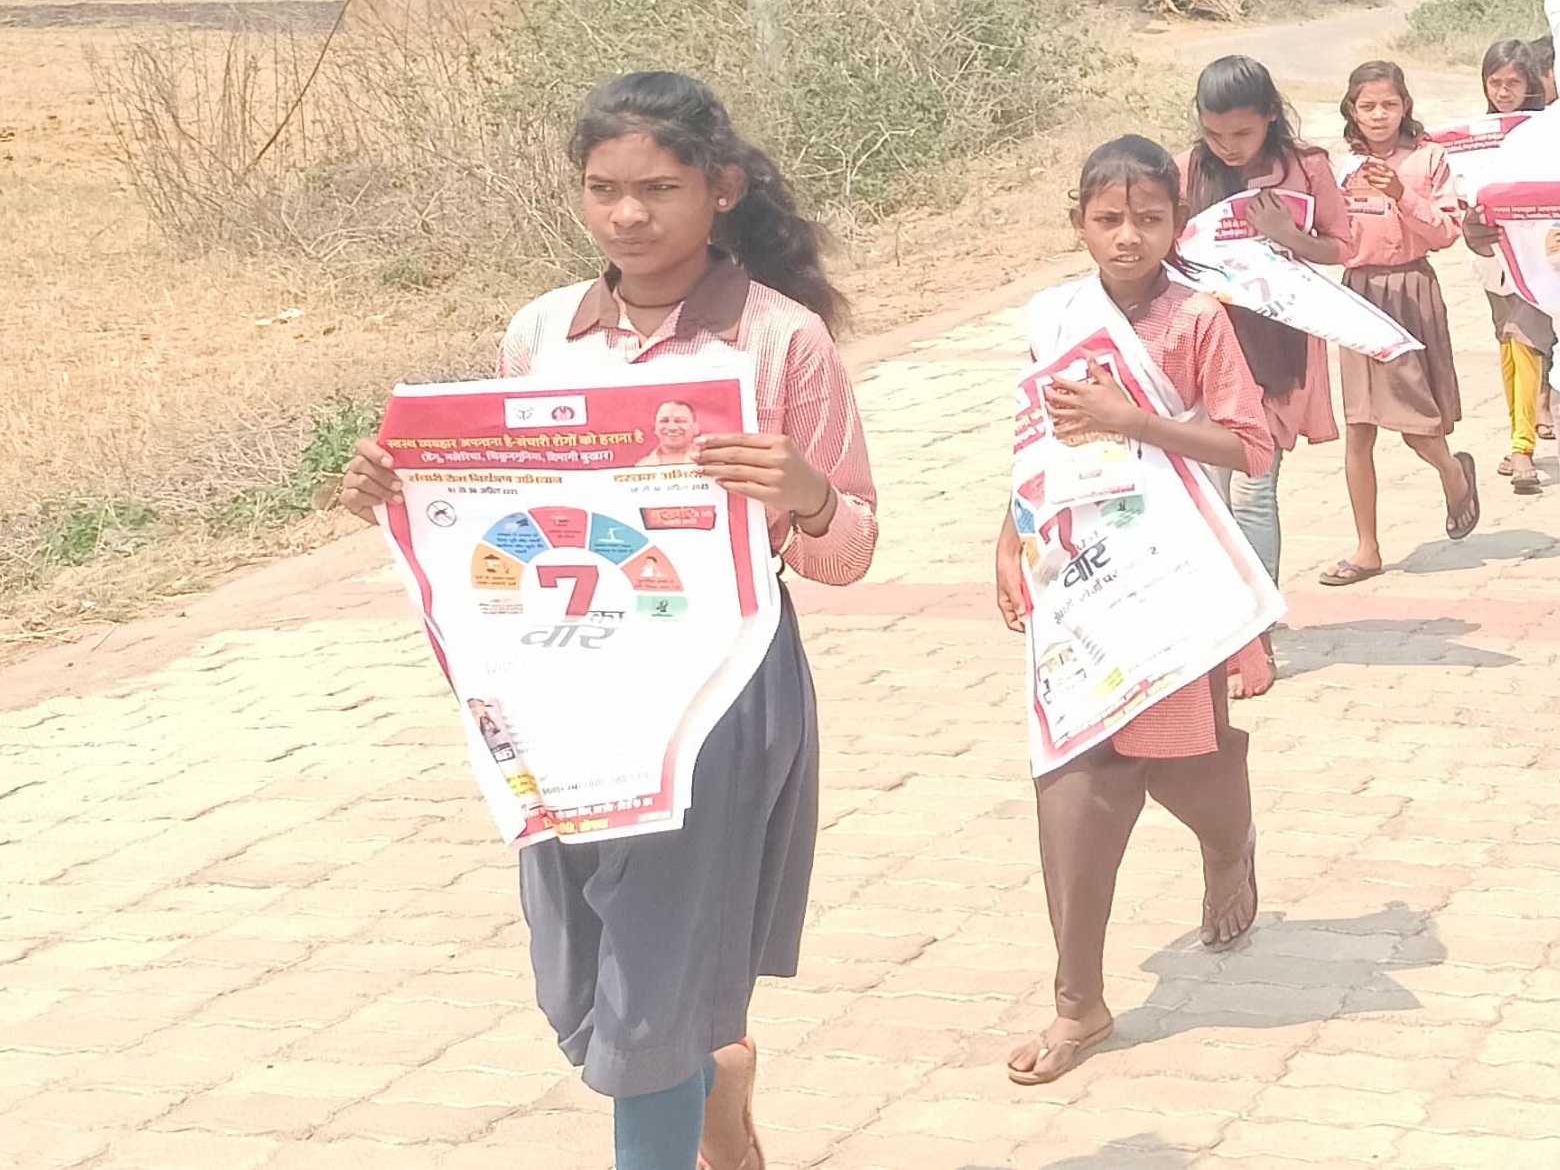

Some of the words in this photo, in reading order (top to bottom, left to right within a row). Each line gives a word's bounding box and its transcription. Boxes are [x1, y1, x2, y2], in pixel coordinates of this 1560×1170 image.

[579, 432, 598, 446] को
[599, 432, 632, 446] हराना
[634, 428, 644, 444] है
[1038, 506, 1080, 561] 7
[1061, 535, 1112, 588] वार
[536, 564, 600, 621] 7
[520, 624, 620, 650] वार
